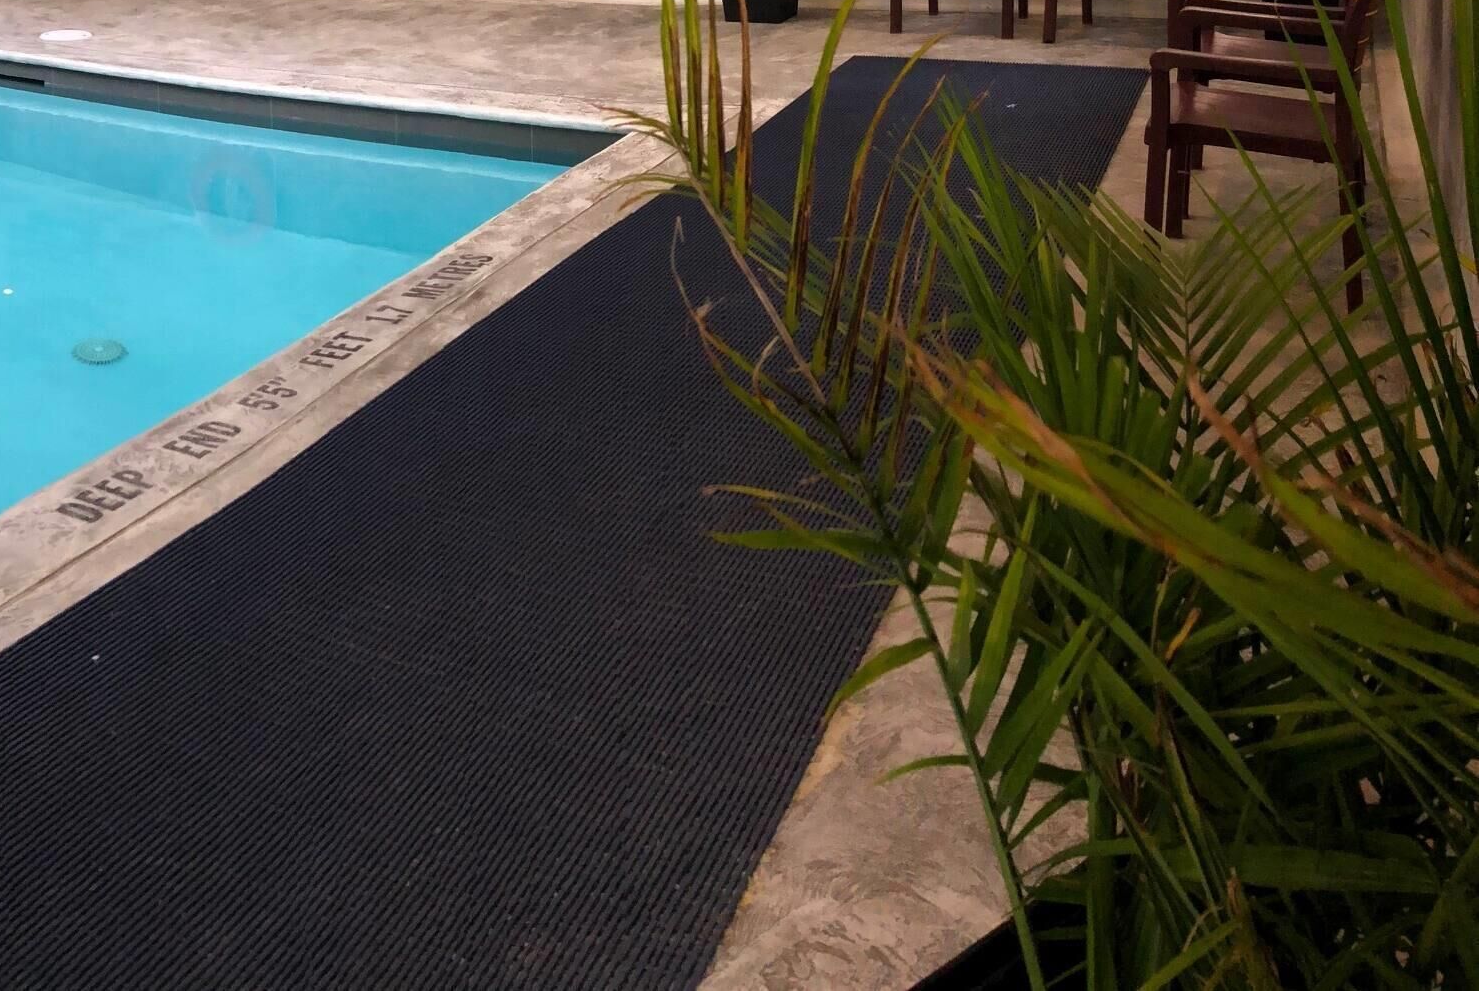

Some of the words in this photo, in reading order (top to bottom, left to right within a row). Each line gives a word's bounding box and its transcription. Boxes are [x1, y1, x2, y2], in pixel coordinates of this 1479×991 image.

[55, 469, 154, 524] DEEP
[162, 420, 242, 460] END
[298, 330, 373, 369] FEET
[365, 304, 414, 325] 1.7
[401, 253, 494, 299] METRES
